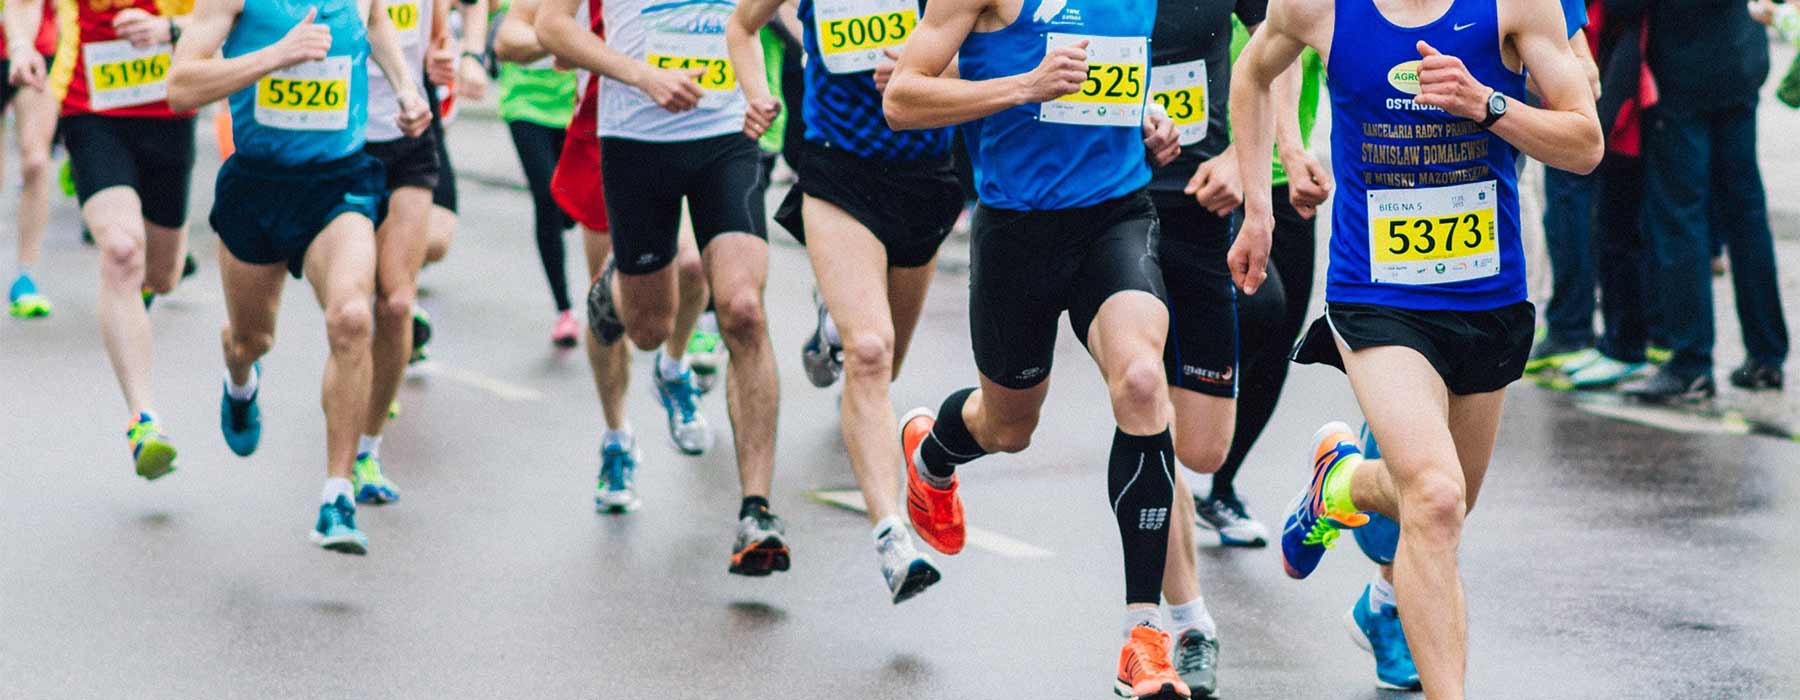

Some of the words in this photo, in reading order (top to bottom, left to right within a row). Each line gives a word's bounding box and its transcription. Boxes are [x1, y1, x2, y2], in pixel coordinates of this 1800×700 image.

[830, 13, 906, 48] 5003
[101, 55, 164, 86] 5196
[1083, 65, 1140, 98] 525
[1394, 72, 1418, 81] AGR
[269, 79, 339, 106] 5526
[1153, 90, 1193, 119] 23
[1363, 122, 1413, 139] KANCELARIA
[1415, 125, 1443, 138] RADCY
[1379, 203, 1399, 211] BIEG
[1402, 203, 1414, 211] NA
[1416, 202, 1422, 210] 5
[1388, 213, 1483, 255] 5373
